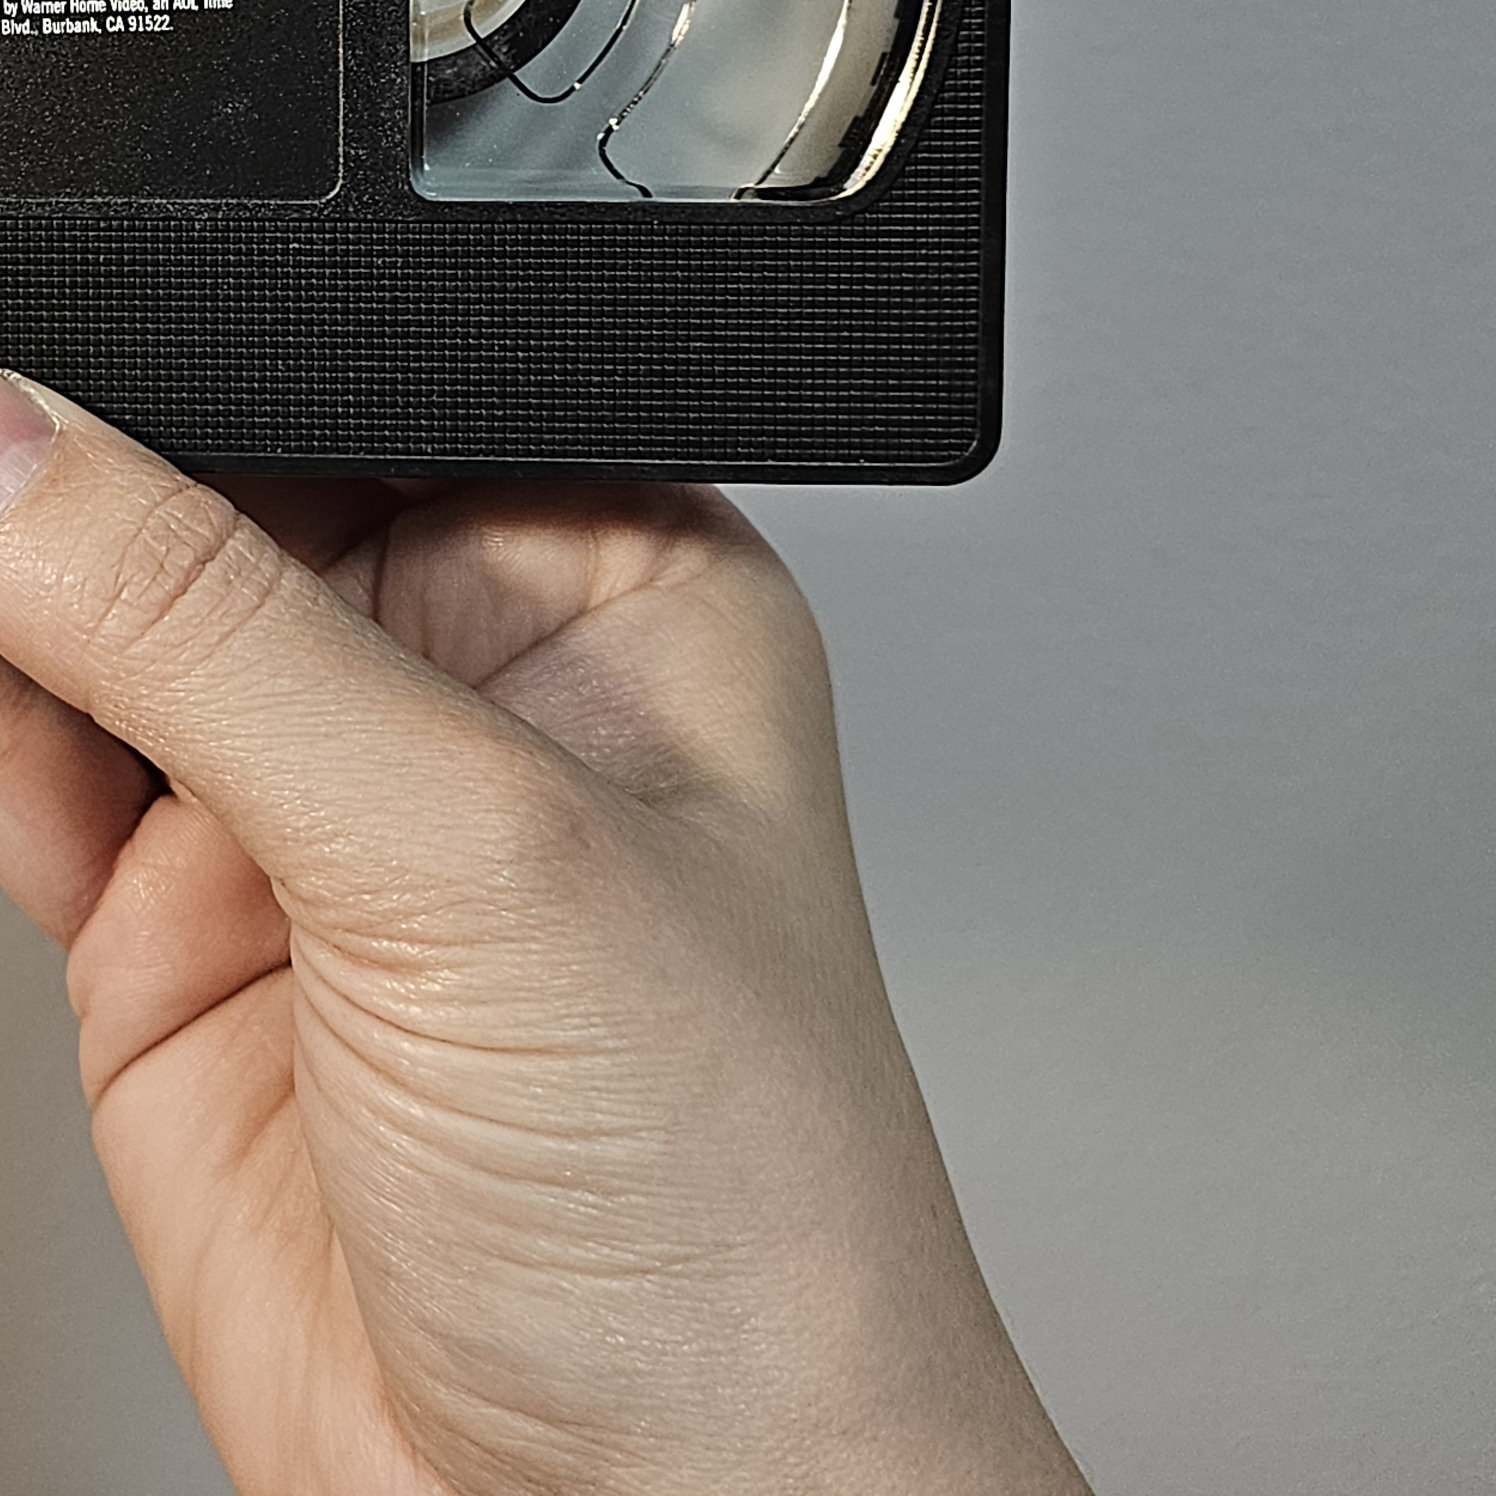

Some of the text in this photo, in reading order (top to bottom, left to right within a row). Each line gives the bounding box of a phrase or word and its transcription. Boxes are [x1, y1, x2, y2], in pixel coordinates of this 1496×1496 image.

[42, 17, 102, 35] Burbank,
[105, 16, 125, 33] CA
[128, 15, 174, 32] 91522.
